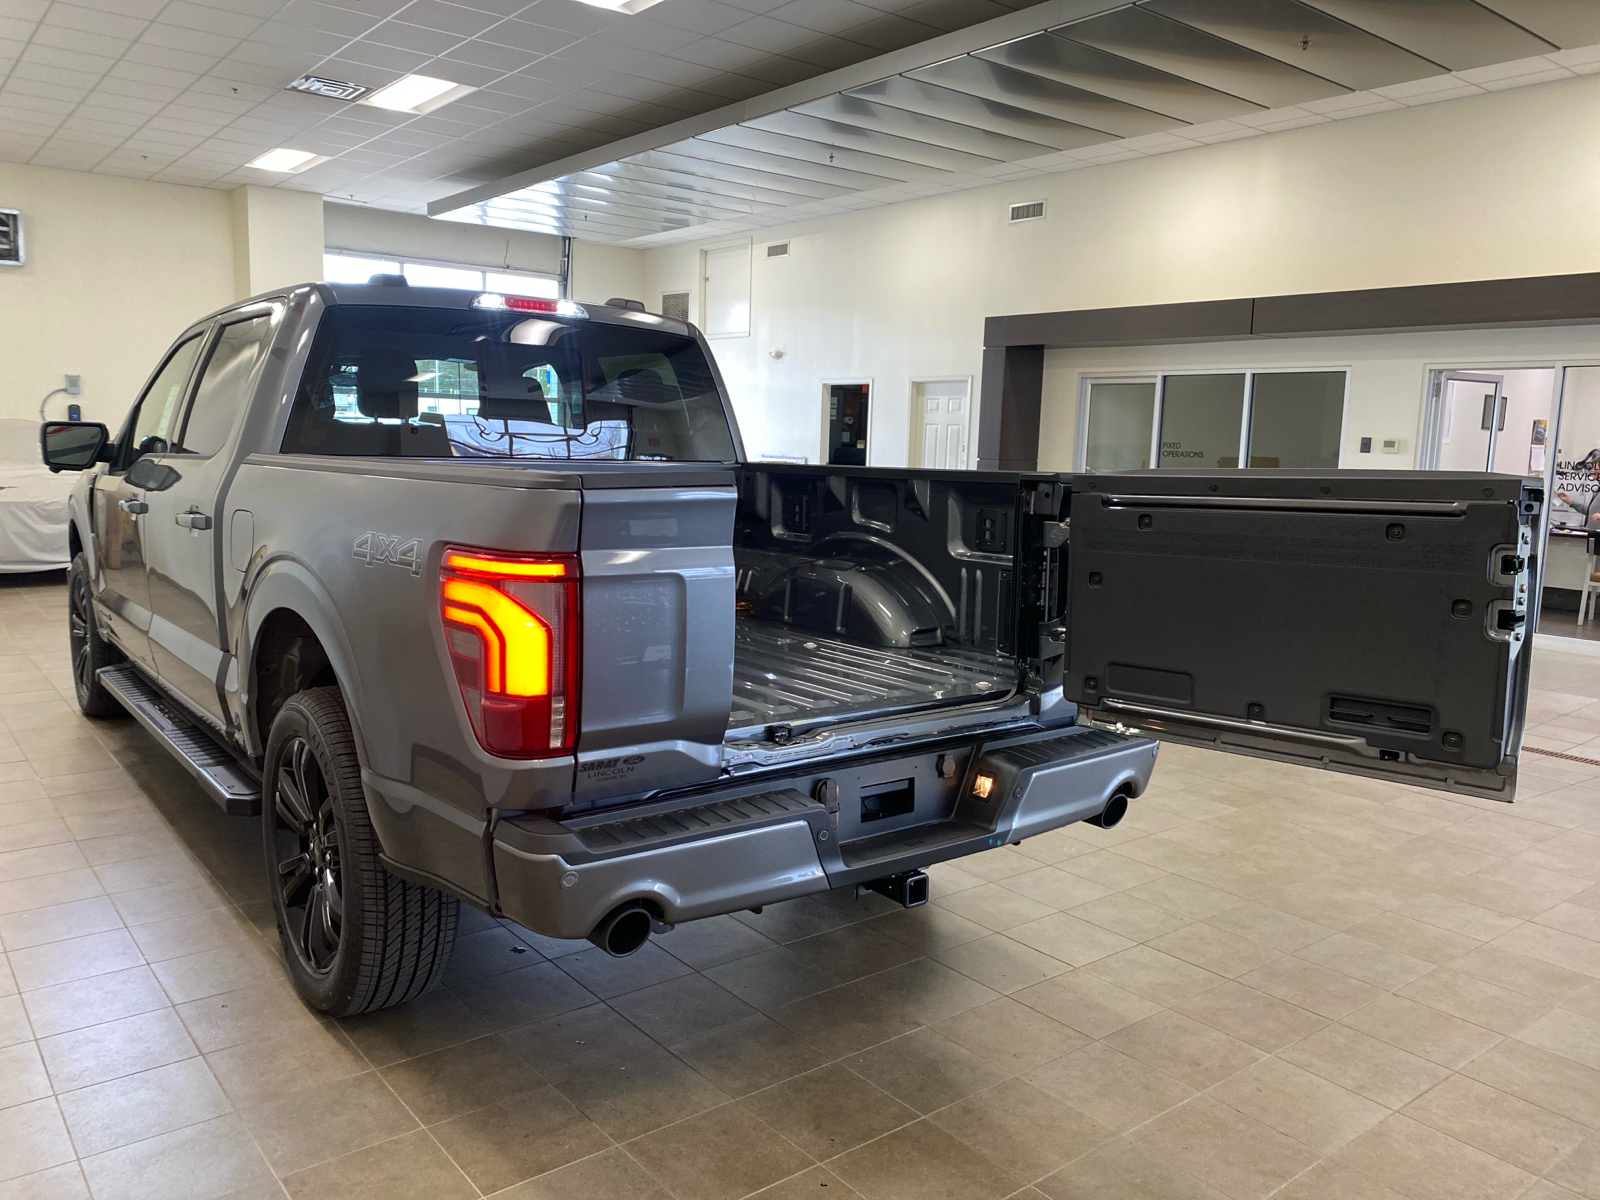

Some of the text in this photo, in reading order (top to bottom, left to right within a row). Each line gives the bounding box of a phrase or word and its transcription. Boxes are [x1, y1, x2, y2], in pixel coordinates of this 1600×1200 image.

[1162, 450, 1204, 458] OPERATIONS
[579, 758, 621, 773] SARAT
[587, 766, 634, 779] LINCOLN
